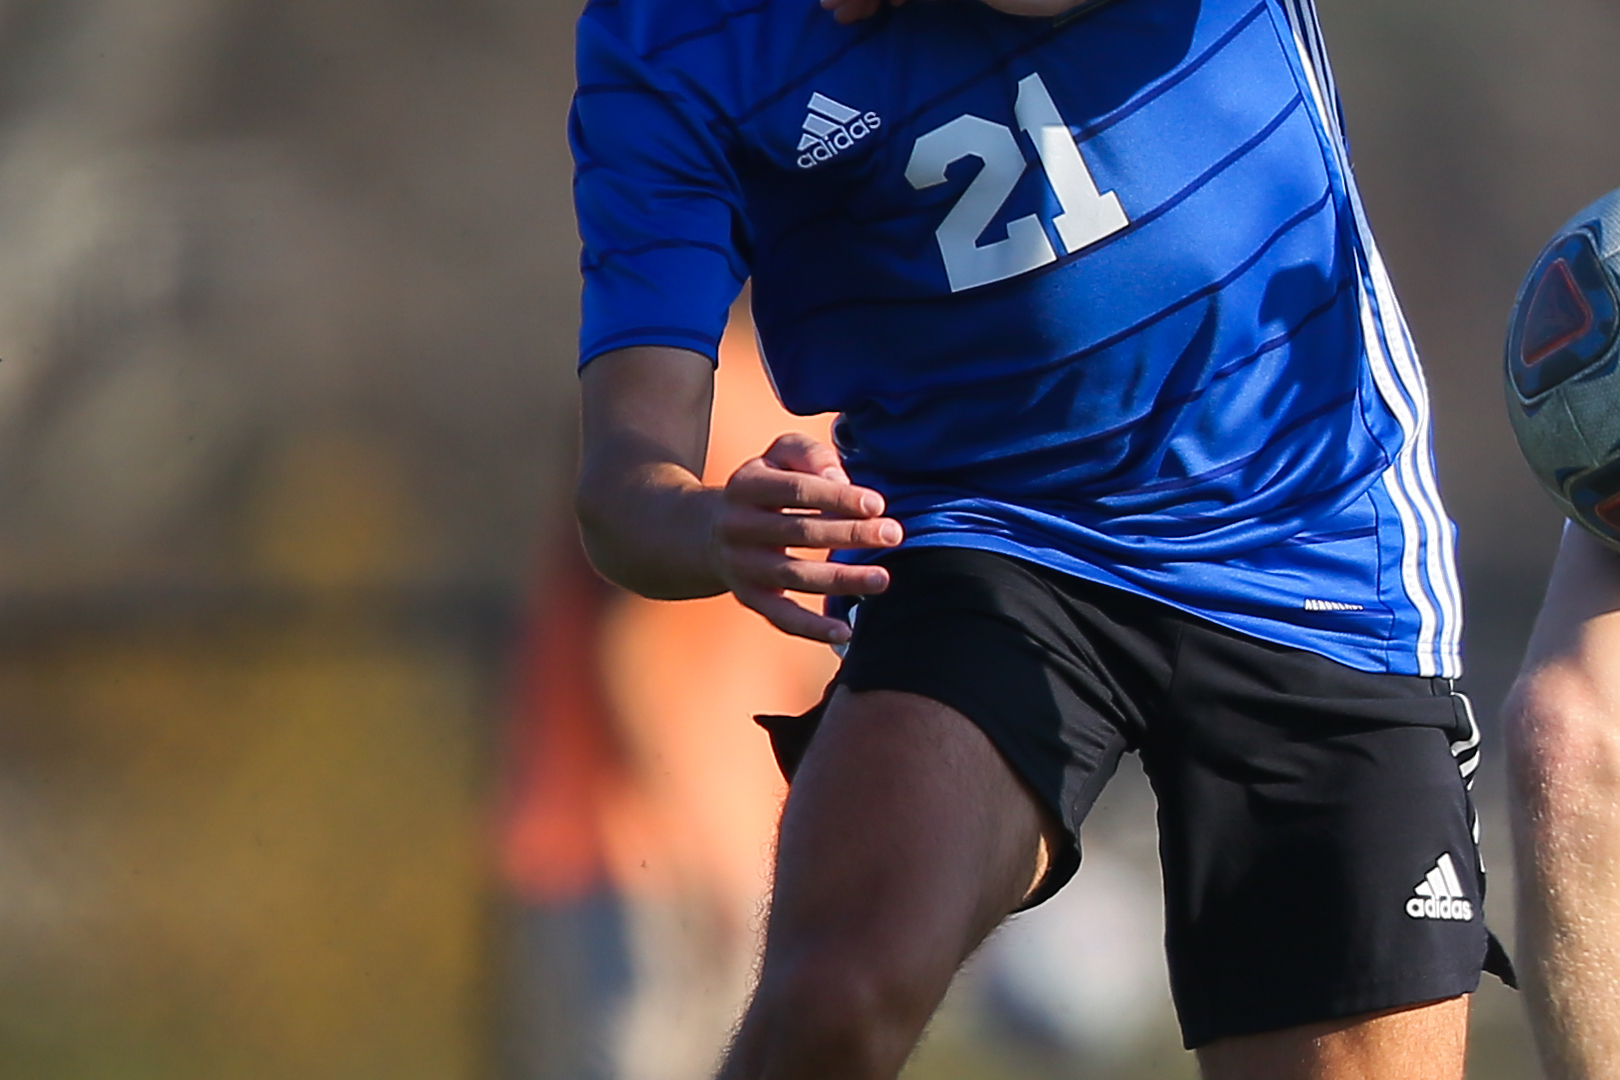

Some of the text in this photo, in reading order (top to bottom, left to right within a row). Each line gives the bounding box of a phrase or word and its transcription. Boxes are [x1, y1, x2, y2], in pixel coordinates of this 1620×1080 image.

[797, 110, 881, 169] adidas
[905, 73, 1130, 292] 21
[1406, 896, 1474, 920] adidas
